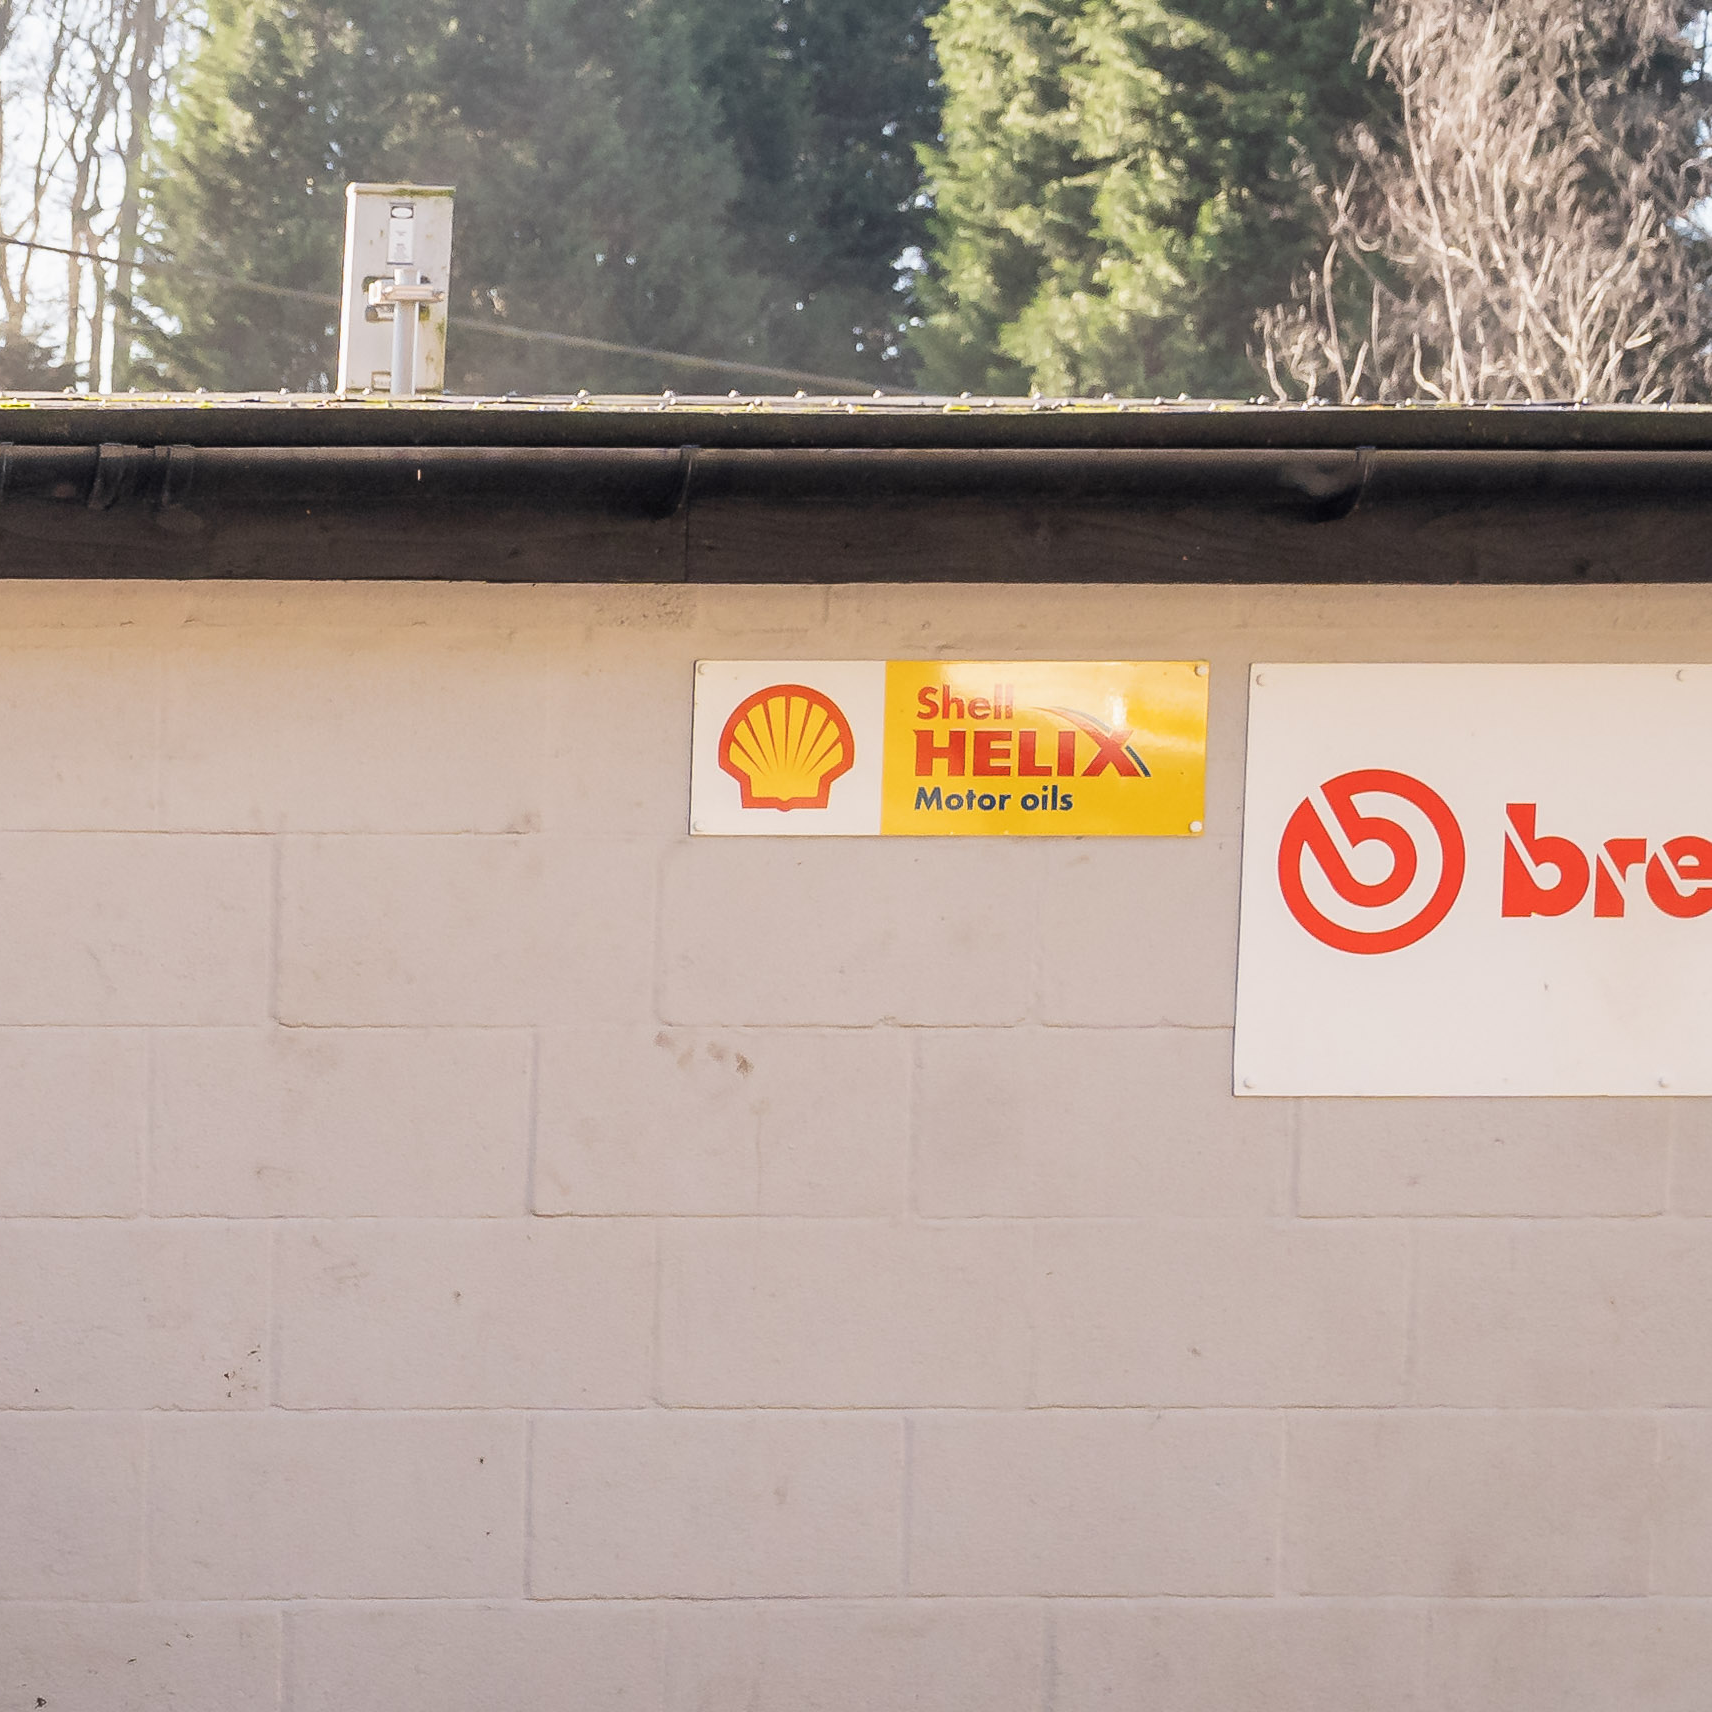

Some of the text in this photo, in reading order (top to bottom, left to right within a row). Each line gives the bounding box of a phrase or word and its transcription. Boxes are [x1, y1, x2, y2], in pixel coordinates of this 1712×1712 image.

[916, 685, 1014, 720] Shell
[913, 729, 1139, 778] HELIX
[914, 785, 1073, 811] Motor oils
